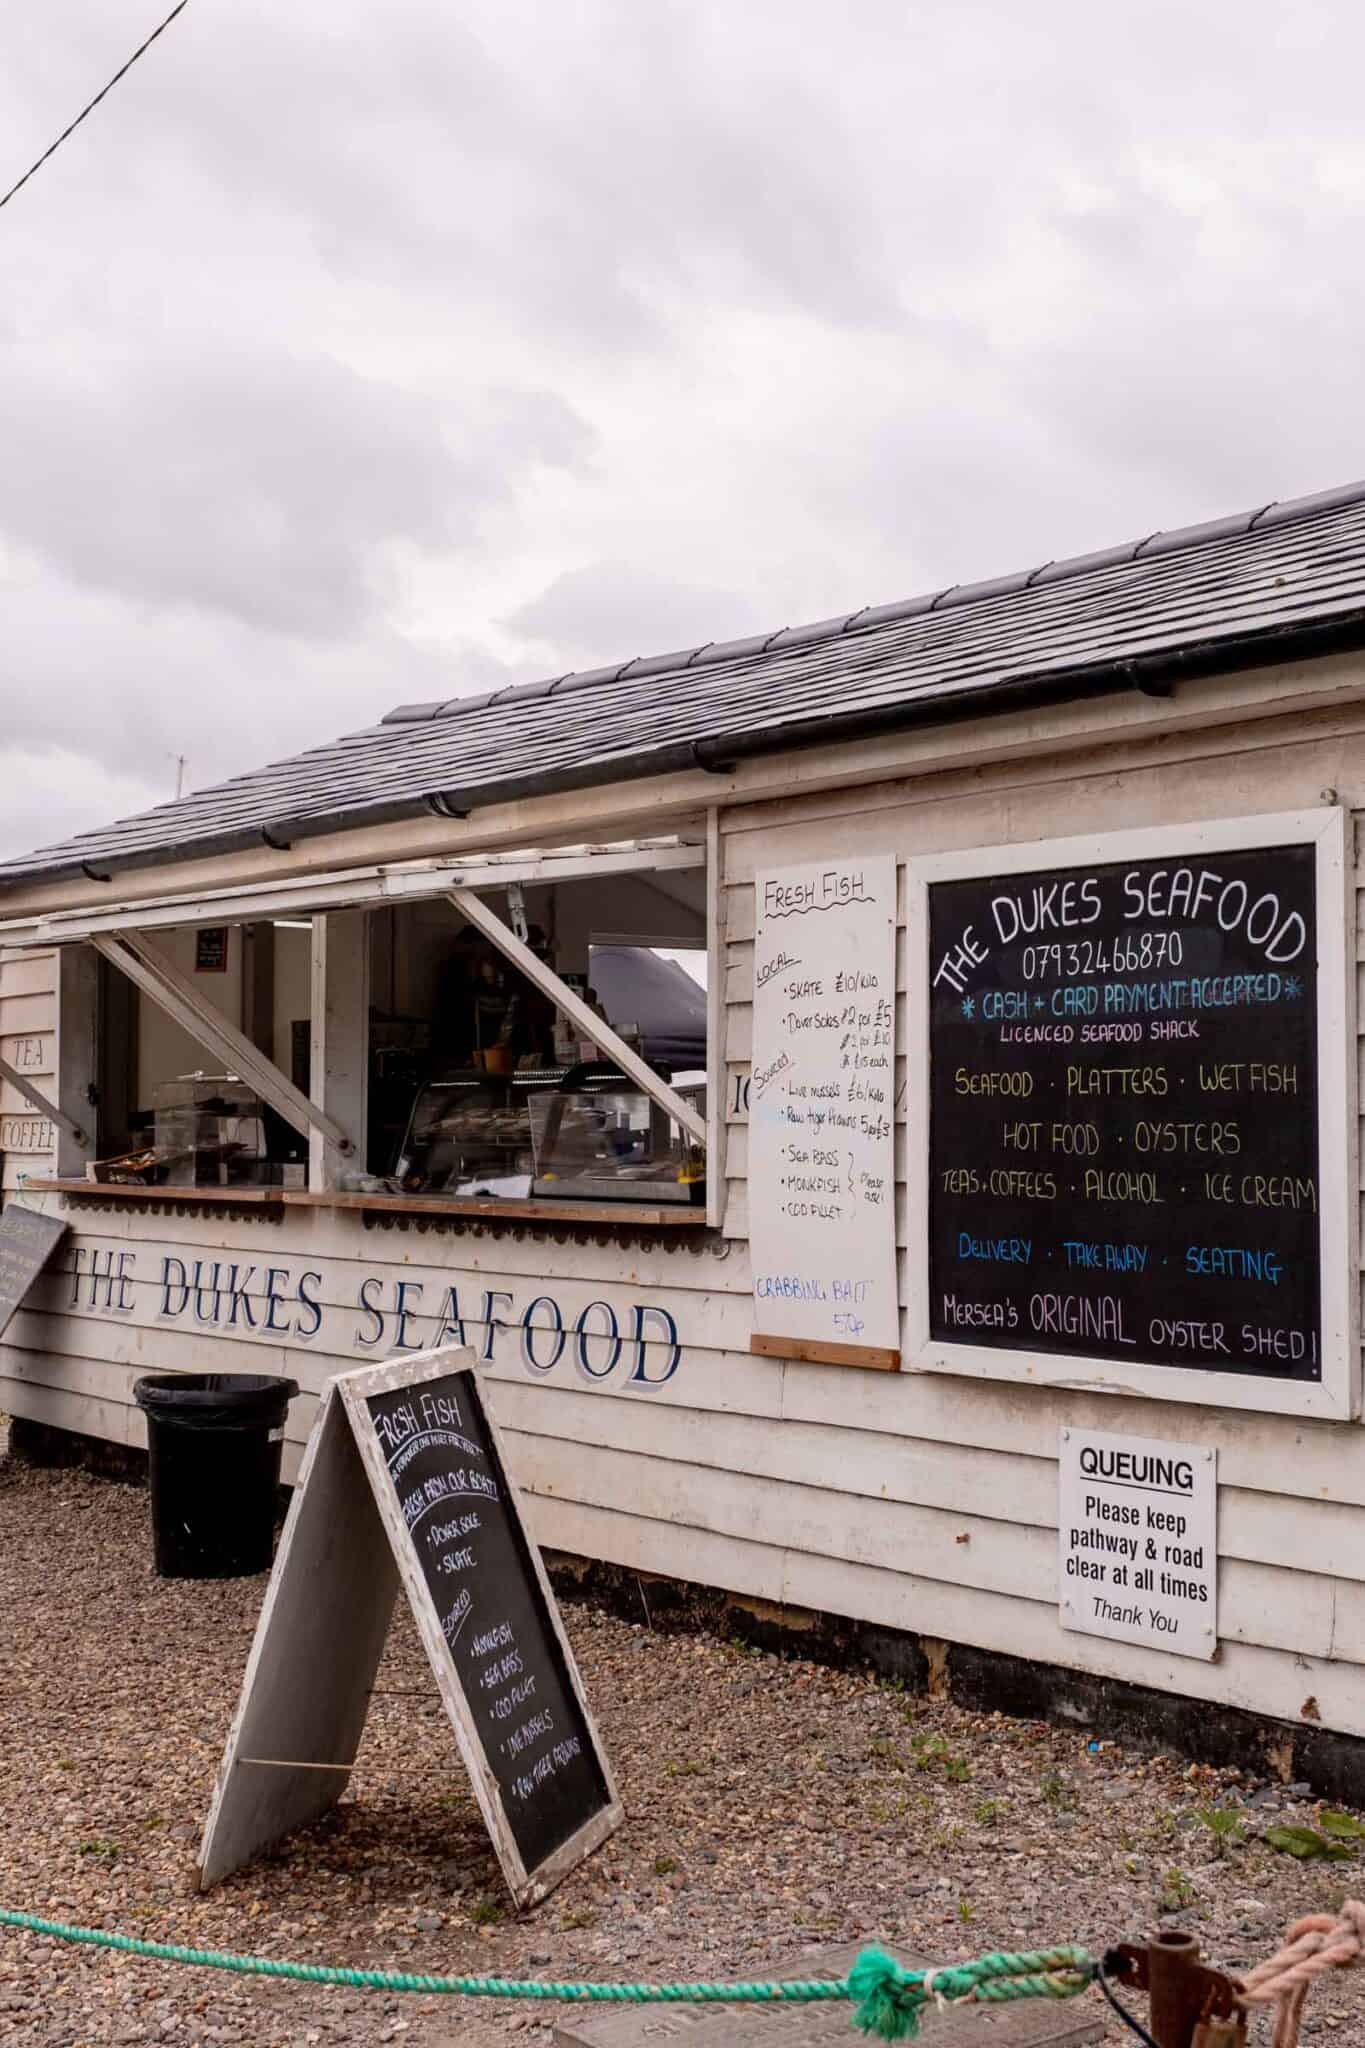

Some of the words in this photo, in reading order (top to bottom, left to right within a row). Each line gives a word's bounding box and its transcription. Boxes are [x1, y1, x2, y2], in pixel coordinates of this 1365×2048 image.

[764, 880, 815, 909] FRESH
[822, 872, 864, 899] FISH
[933, 926, 989, 993] THE
[991, 878, 1101, 944] DUKES
[1124, 869, 1306, 962] SEAFOOD
[756, 952, 796, 983] LOCAL
[1022, 931, 1183, 981] 07932466870
[789, 981, 823, 1000] SKATE
[982, 991, 1028, 1019] CASH
[1050, 986, 1097, 1017] CARD
[1103, 981, 1184, 1014] PAYMENT
[1189, 973, 1281, 1009] ACCEPTED
[1000, 1023, 1074, 1043] LICENCED
[1079, 1022, 1143, 1042] SEAFOOD
[1149, 1020, 1200, 1041] SHACK
[14, 1040, 43, 1066] TEA
[955, 1068, 1033, 1096] SEAFOOD
[1067, 1066, 1168, 1096] PLATTERS
[1200, 1064, 1245, 1092] WET
[1250, 1064, 1297, 1094] FISH
[1004, 1122, 1042, 1152] HOT
[1052, 1124, 1100, 1155] FOOD
[1135, 1122, 1241, 1154] OYSTERS
[1086, 1169, 1164, 1202] ALCOHOL
[1204, 1173, 1235, 1203] ICE
[1242, 1175, 1317, 1212] CREAM
[959, 1232, 1032, 1265] DELIVERY
[1186, 1247, 1283, 1285] SEATING
[70, 1248, 136, 1310] THE
[161, 1256, 323, 1335] DUKES
[357, 1278, 682, 1384] SEAFOOD
[1030, 1294, 1137, 1344] ORIGINAL
[1149, 1319, 1231, 1354] OYSTER
[420, 1393, 463, 1430] FISH
[1080, 1447, 1193, 1490] QUEUING
[1086, 1496, 1140, 1526] Please
[1147, 1506, 1186, 1538] keep
[1071, 1528, 1138, 1561] pathway
[1145, 1538, 1157, 1560] &
[1165, 1547, 1203, 1569] road
[1066, 1556, 1106, 1581] clear
[1113, 1565, 1128, 1586] at
[1135, 1569, 1154, 1591] all
[1161, 1573, 1208, 1601] times
[1093, 1597, 1143, 1625] Thank
[1149, 1609, 1179, 1633] You
